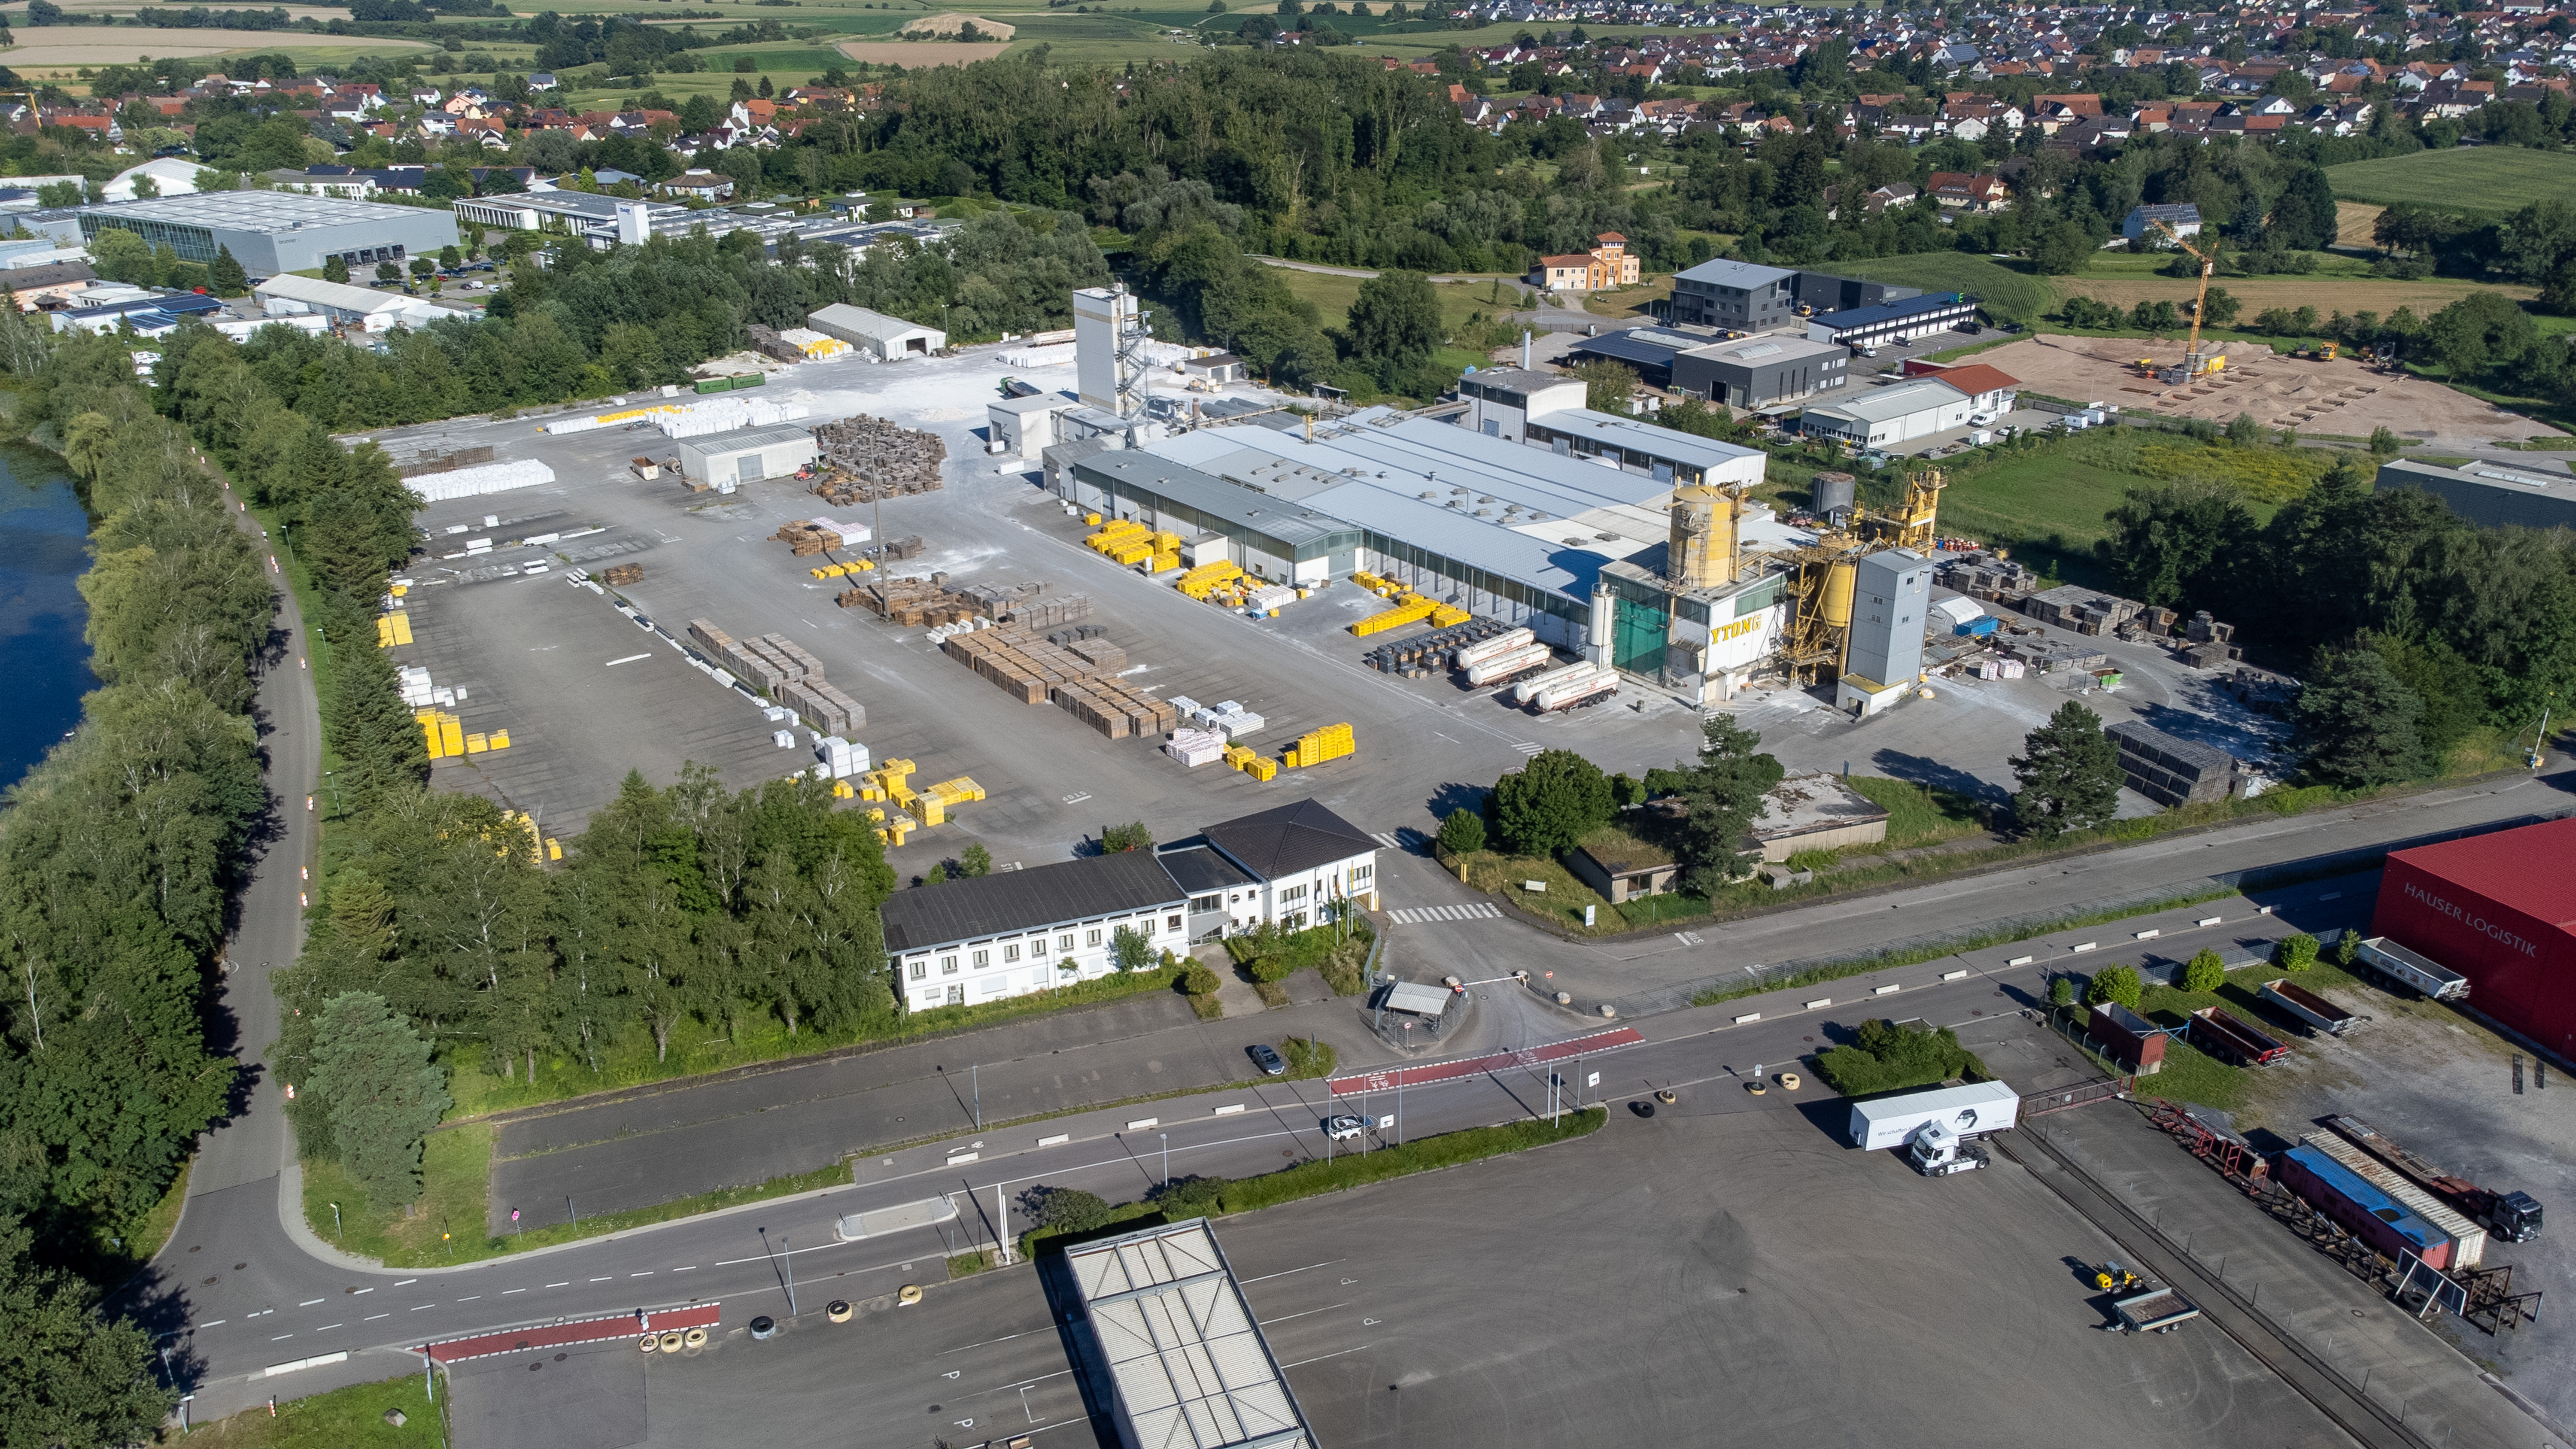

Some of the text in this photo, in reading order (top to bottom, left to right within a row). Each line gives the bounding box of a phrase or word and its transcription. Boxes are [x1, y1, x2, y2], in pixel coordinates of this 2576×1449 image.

[1915, 511, 1930, 520] YTONG
[1710, 614, 1762, 645] YTONG
[1063, 790, 1087, 801] STOP
[2404, 882, 2537, 958] HAUSER LOGISTIK
[1684, 931, 1704, 944] STOP
[941, 1370, 960, 1379] P
[954, 1418, 973, 1428] P
